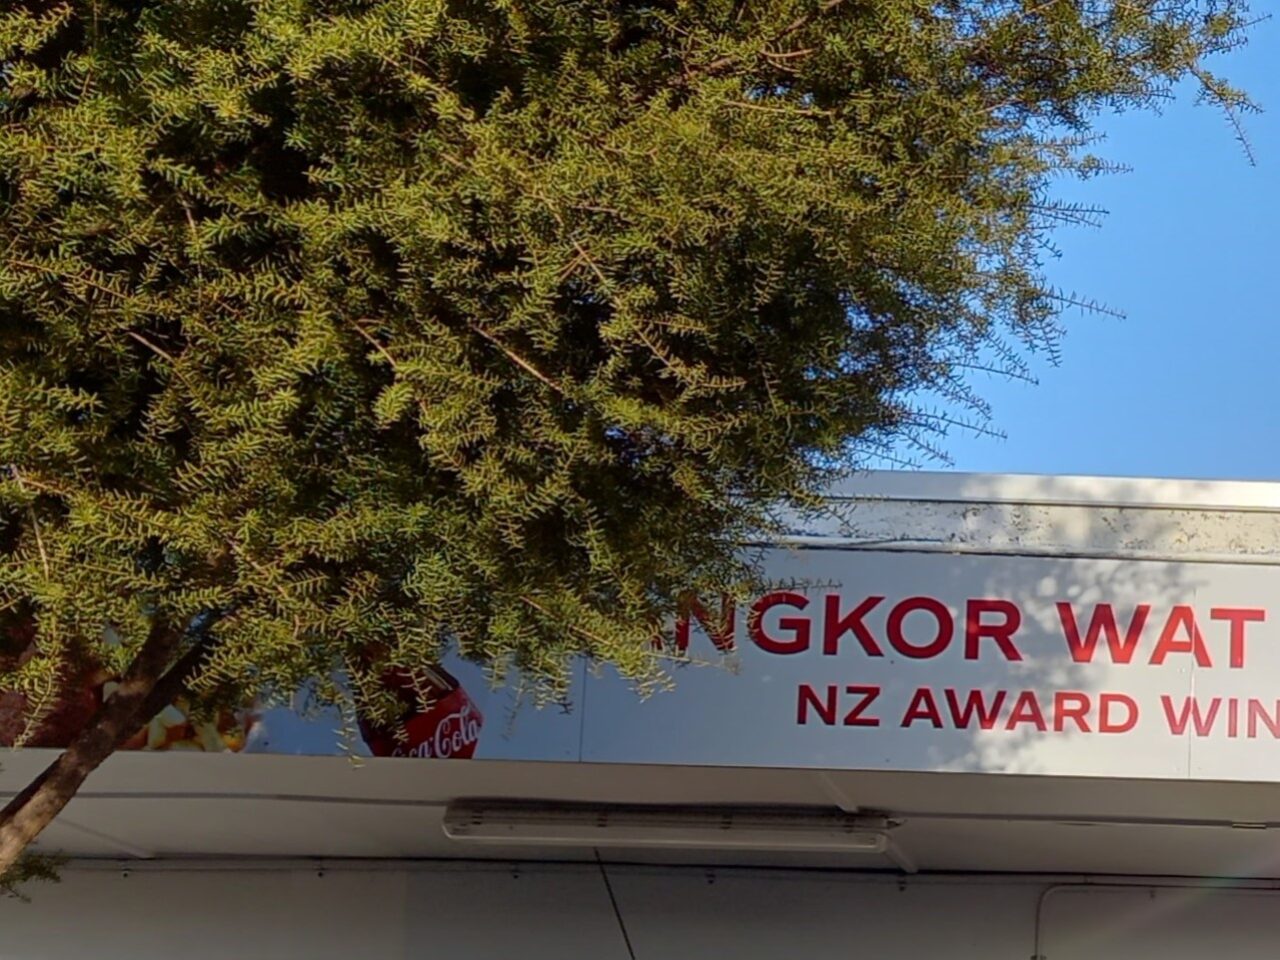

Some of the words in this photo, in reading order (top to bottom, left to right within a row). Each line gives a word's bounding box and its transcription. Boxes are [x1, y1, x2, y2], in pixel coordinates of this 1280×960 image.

[650, 590, 1021, 662] NGKOR
[1056, 601, 1265, 669] WAT
[796, 684, 881, 727] NZ
[900, 686, 1139, 734] AWARD
